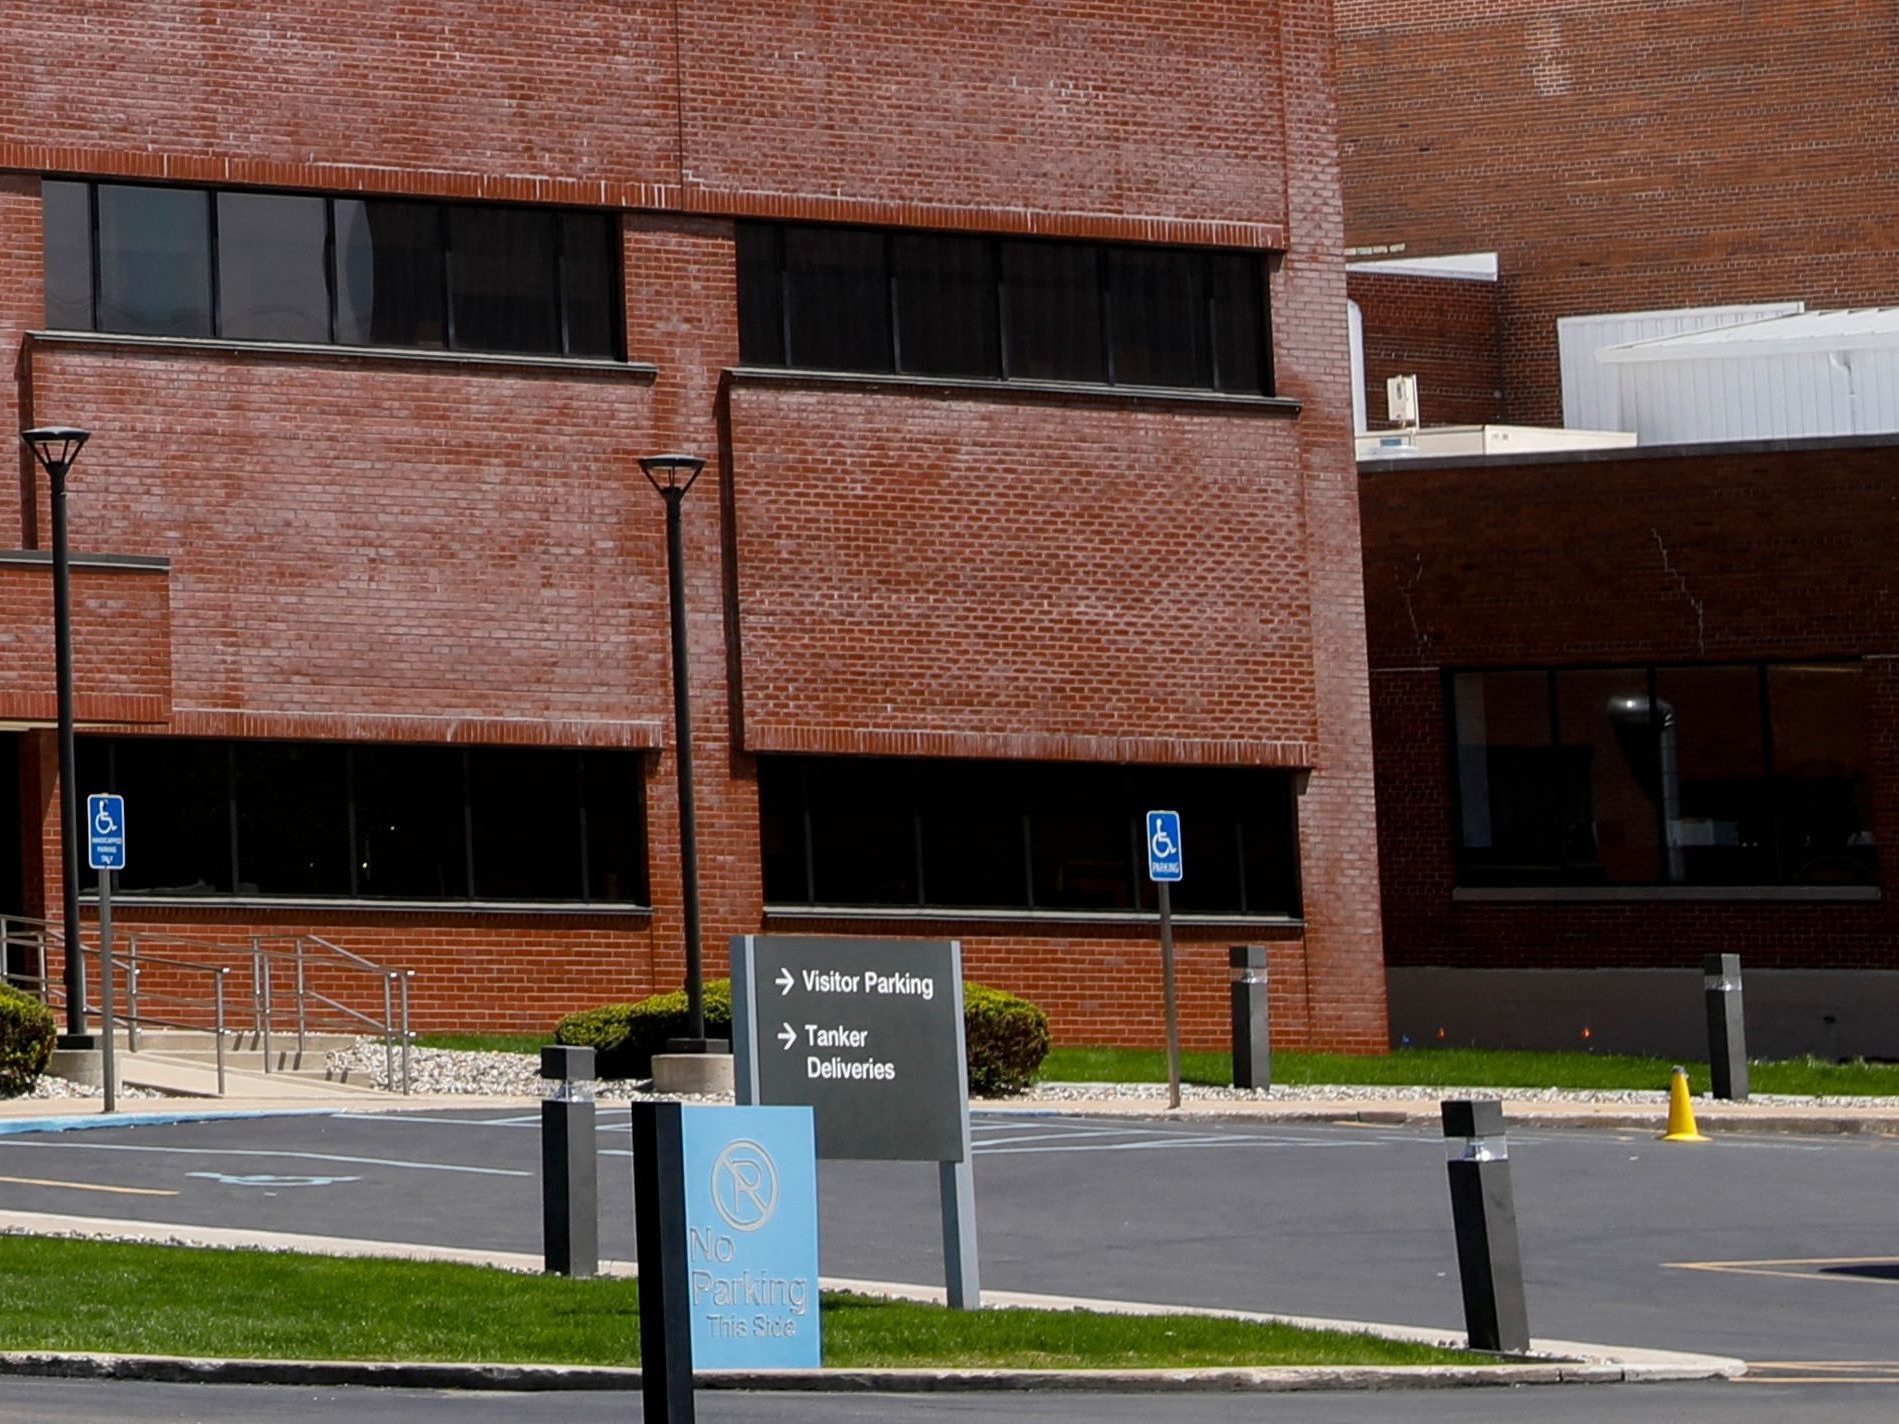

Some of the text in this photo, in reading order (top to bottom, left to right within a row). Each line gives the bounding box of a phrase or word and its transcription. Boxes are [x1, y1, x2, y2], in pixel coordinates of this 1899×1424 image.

[1152, 862, 1180, 873] PARKING
[802, 969, 934, 1000] Visitor Parking
[805, 1024, 868, 1048] Tanker
[807, 1056, 896, 1080] Deliveries
[690, 1225, 735, 1264] No
[691, 1269, 808, 1316] Parking
[706, 1313, 796, 1339] This Side
